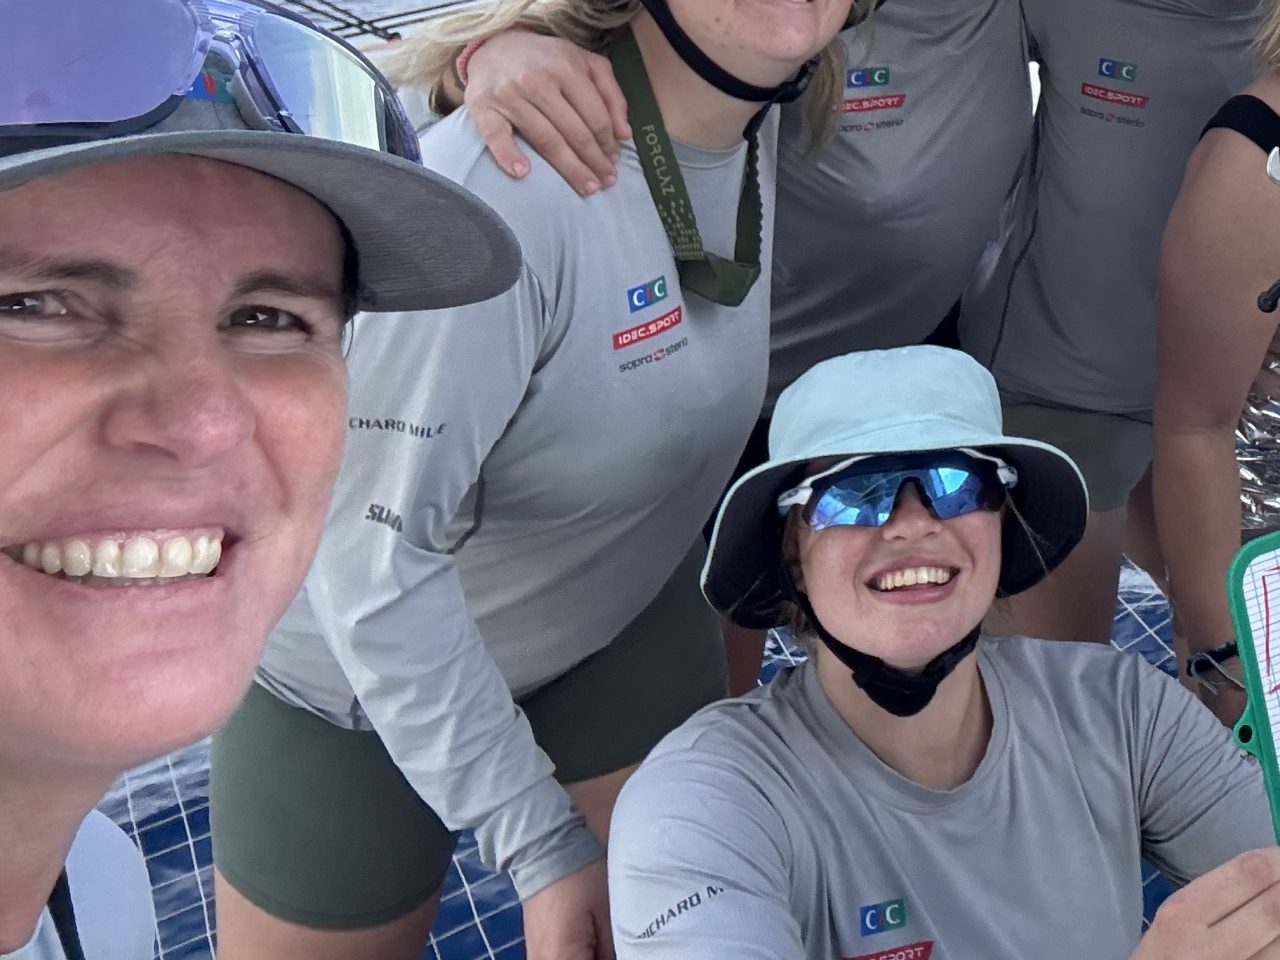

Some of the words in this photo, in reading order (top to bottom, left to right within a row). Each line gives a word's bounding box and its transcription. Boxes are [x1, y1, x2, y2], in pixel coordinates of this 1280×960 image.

[850, 69, 887, 85] CIC
[1101, 61, 1134, 79] CIC
[838, 124, 863, 133] opra
[641, 124, 676, 196] FORCLAZ
[632, 279, 665, 307] CIC
[618, 311, 680, 344] IDEC.SPORT
[619, 354, 653, 373] sopra
[865, 904, 901, 930] CIC
